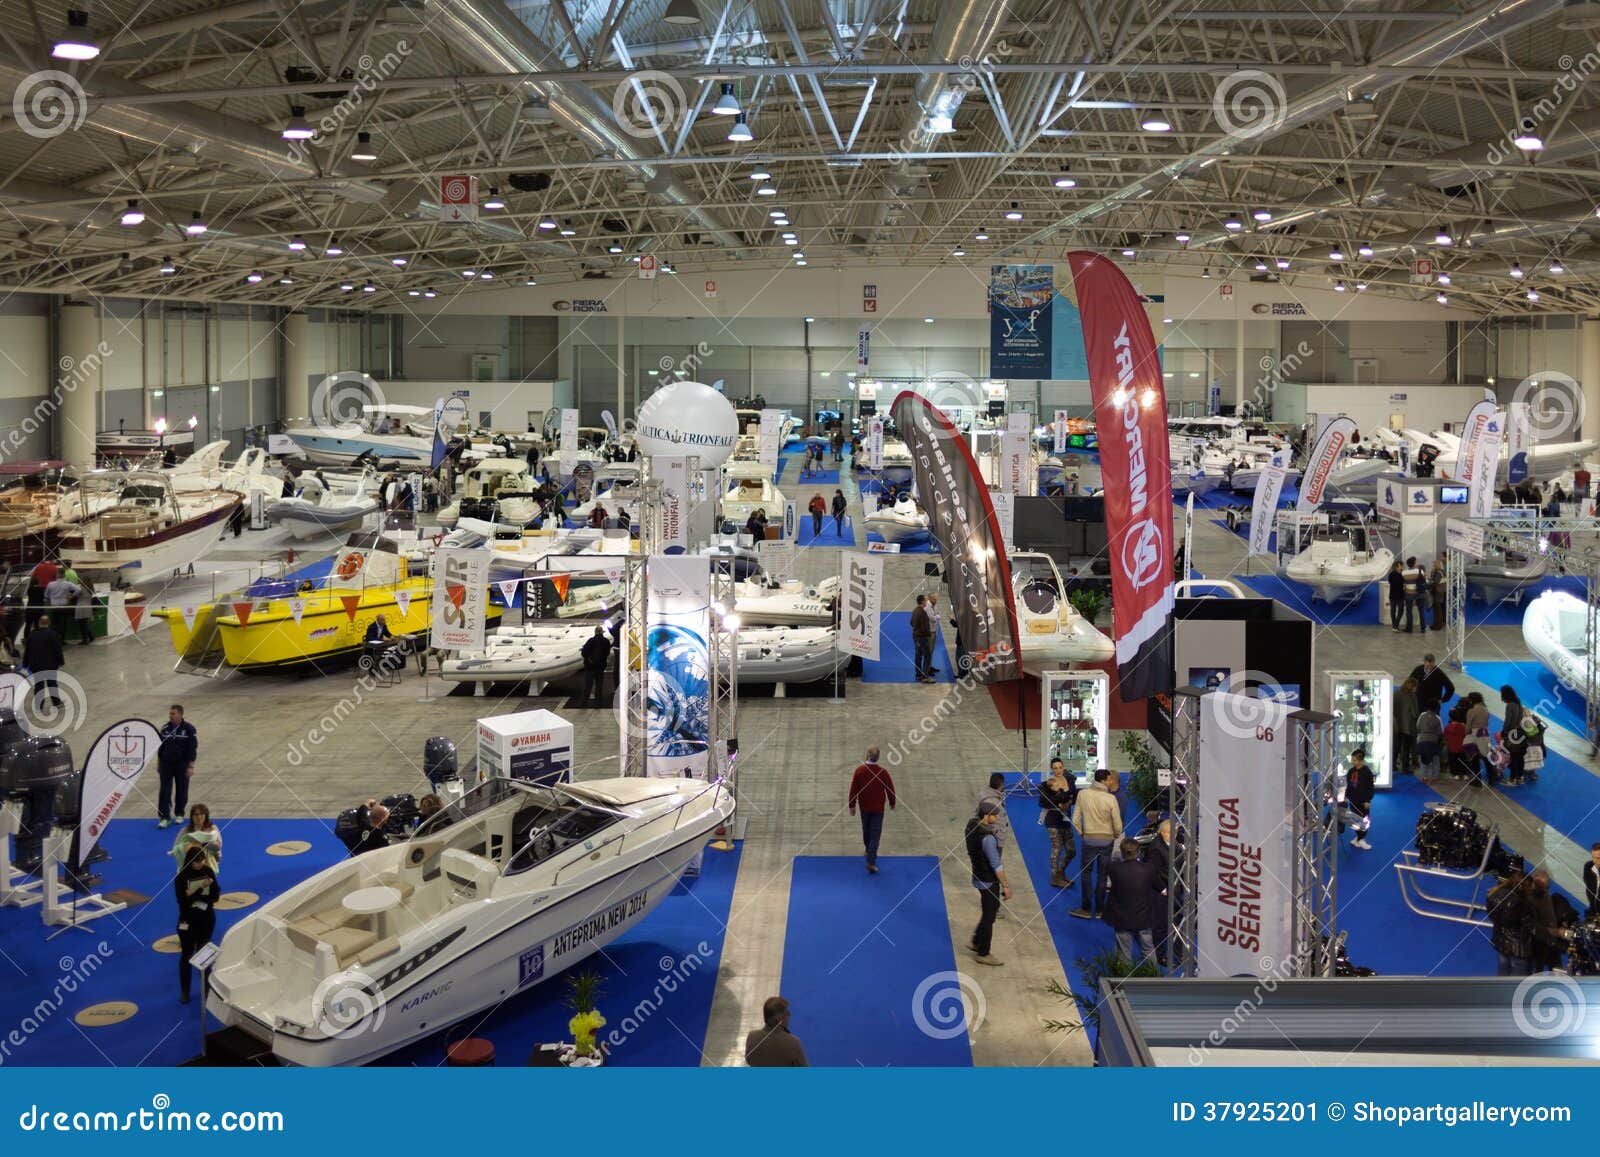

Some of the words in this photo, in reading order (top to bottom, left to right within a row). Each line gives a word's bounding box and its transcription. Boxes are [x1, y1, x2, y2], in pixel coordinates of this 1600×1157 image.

[638, 424, 670, 440] NAUTICA
[682, 431, 734, 447] TRIONFALE
[670, 498, 679, 540] TRIONFAL
[467, 559, 479, 631] MARINE
[848, 561, 867, 636] SUR
[866, 567, 876, 639] MARINE
[520, 733, 551, 745] YAMAHA
[1255, 722, 1274, 742] C6
[95, 791, 123, 827] YAMAHA
[1217, 797, 1240, 907] NAUTICA
[1237, 843, 1262, 953] SERVICE
[553, 914, 605, 958] ANTEPRIMA
[607, 901, 629, 929] NEW
[628, 890, 648, 916] 2014
[1217, 915, 1238, 946] SL
[400, 981, 453, 1013] KARNIC
